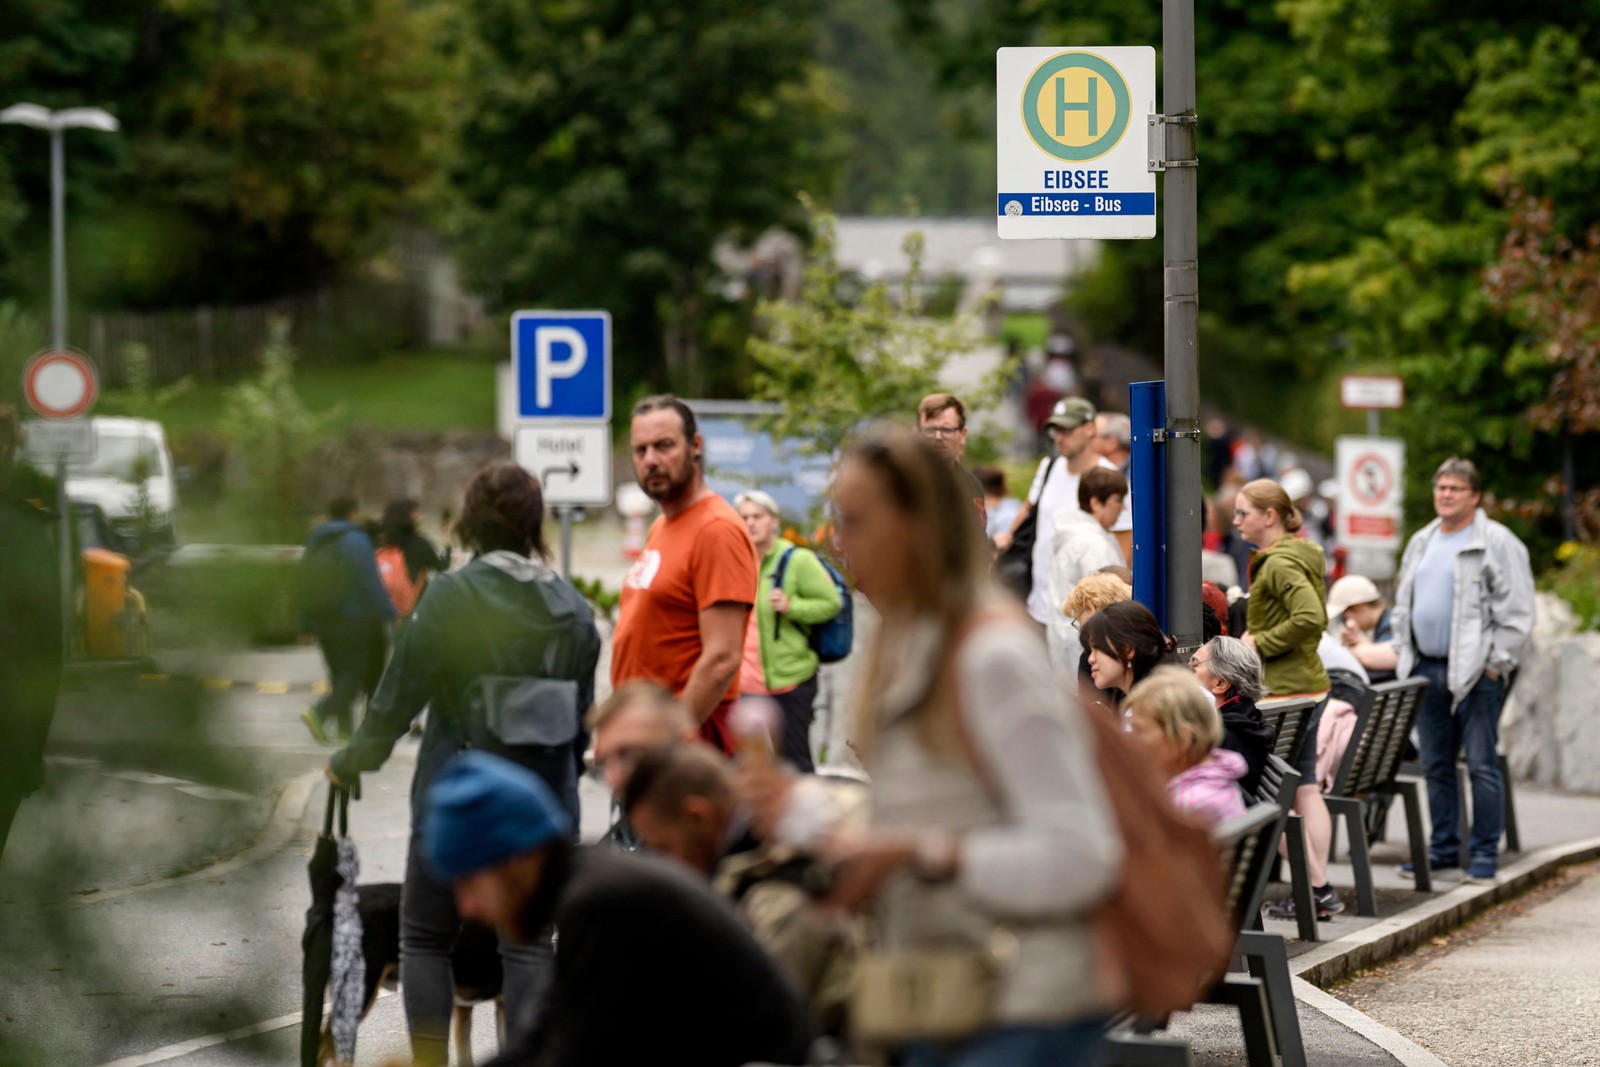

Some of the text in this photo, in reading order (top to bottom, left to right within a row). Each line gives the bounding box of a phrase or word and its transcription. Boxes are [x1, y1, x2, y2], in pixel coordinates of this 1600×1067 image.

[1056, 77, 1097, 136] H
[1044, 170, 1108, 188] EIBSEE
[1031, 196, 1079, 212] Eibsee
[1094, 196, 1121, 212] Bus
[535, 326, 588, 408] P
